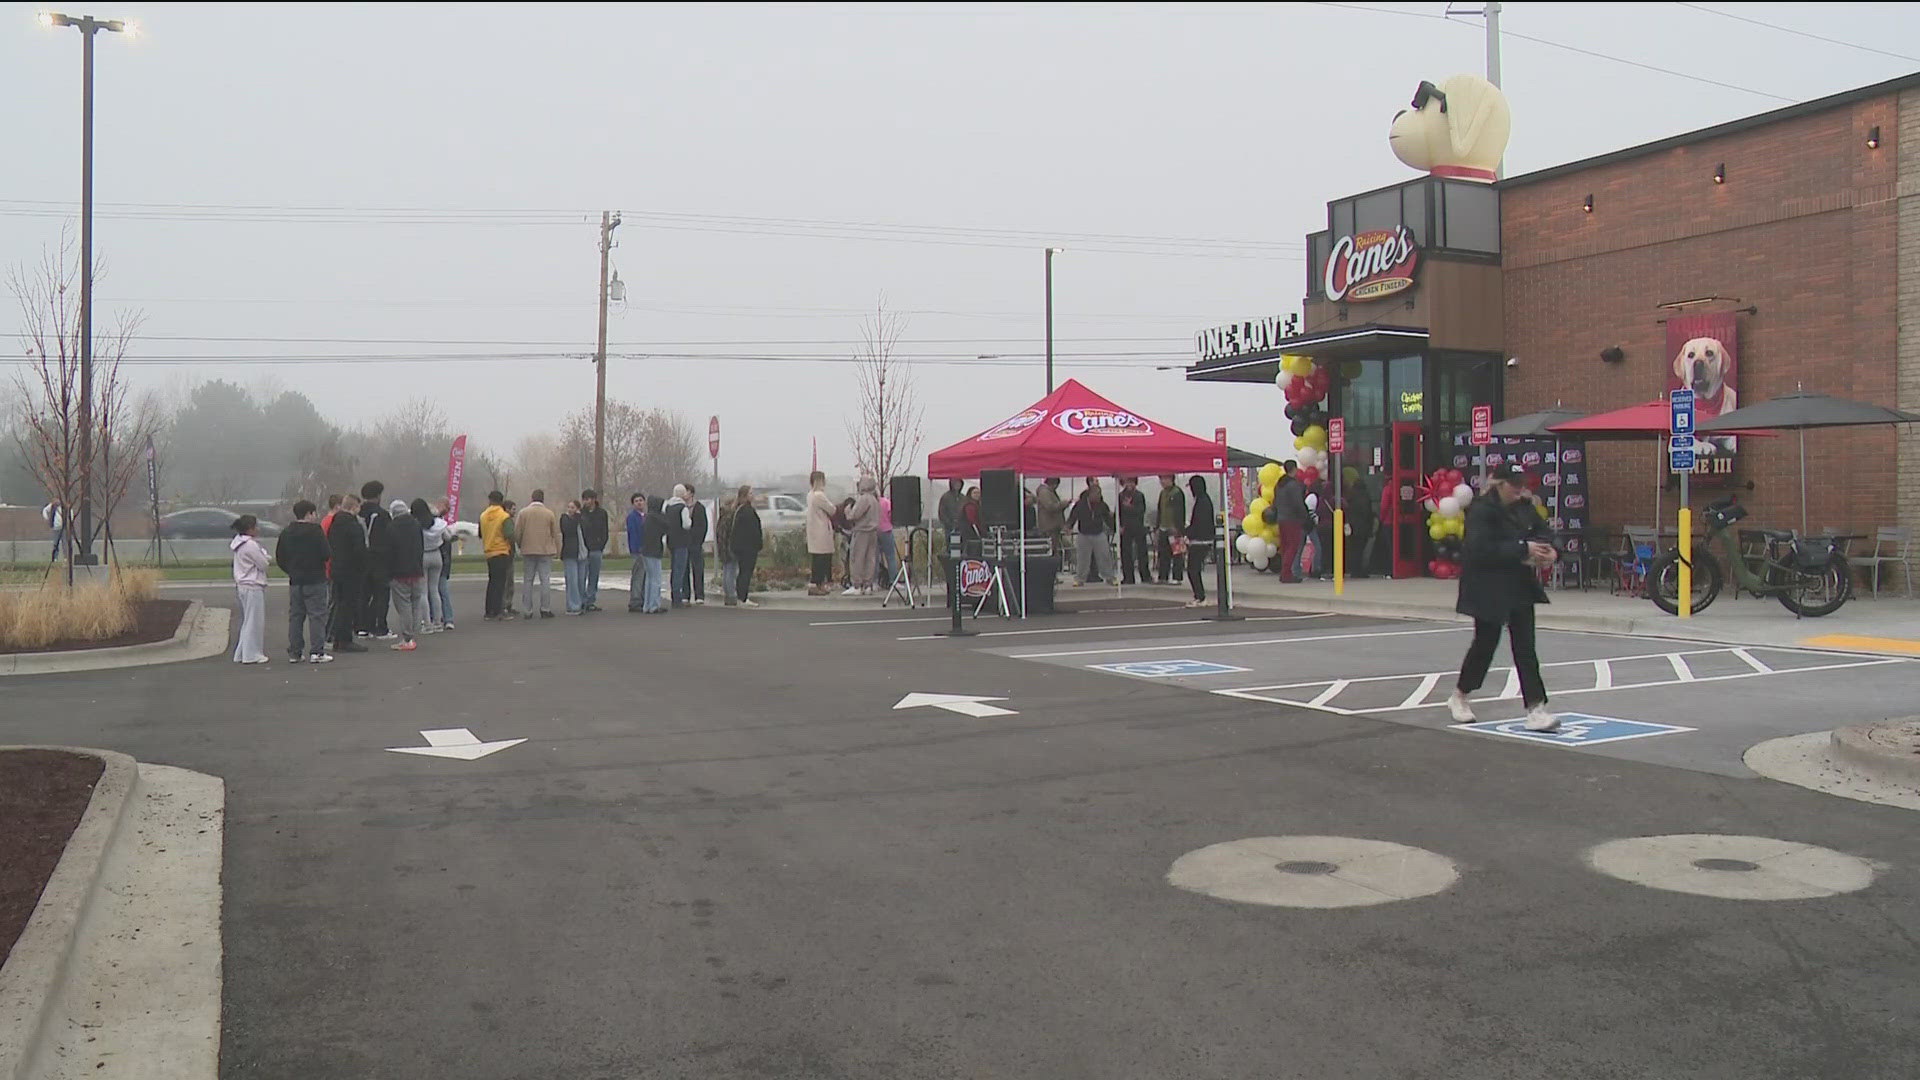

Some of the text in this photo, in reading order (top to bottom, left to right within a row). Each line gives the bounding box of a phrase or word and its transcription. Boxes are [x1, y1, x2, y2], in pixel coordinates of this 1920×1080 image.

[1355, 232, 1387, 251] Raising
[1325, 225, 1413, 301] Cane's
[1194, 323, 1238, 358] ONE
[1060, 409, 1144, 435] Cane's
[452, 461, 461, 491] OPEN
[1713, 458, 1732, 474] III
[448, 495, 457, 522] NOW
[960, 560, 992, 595] Cane's
